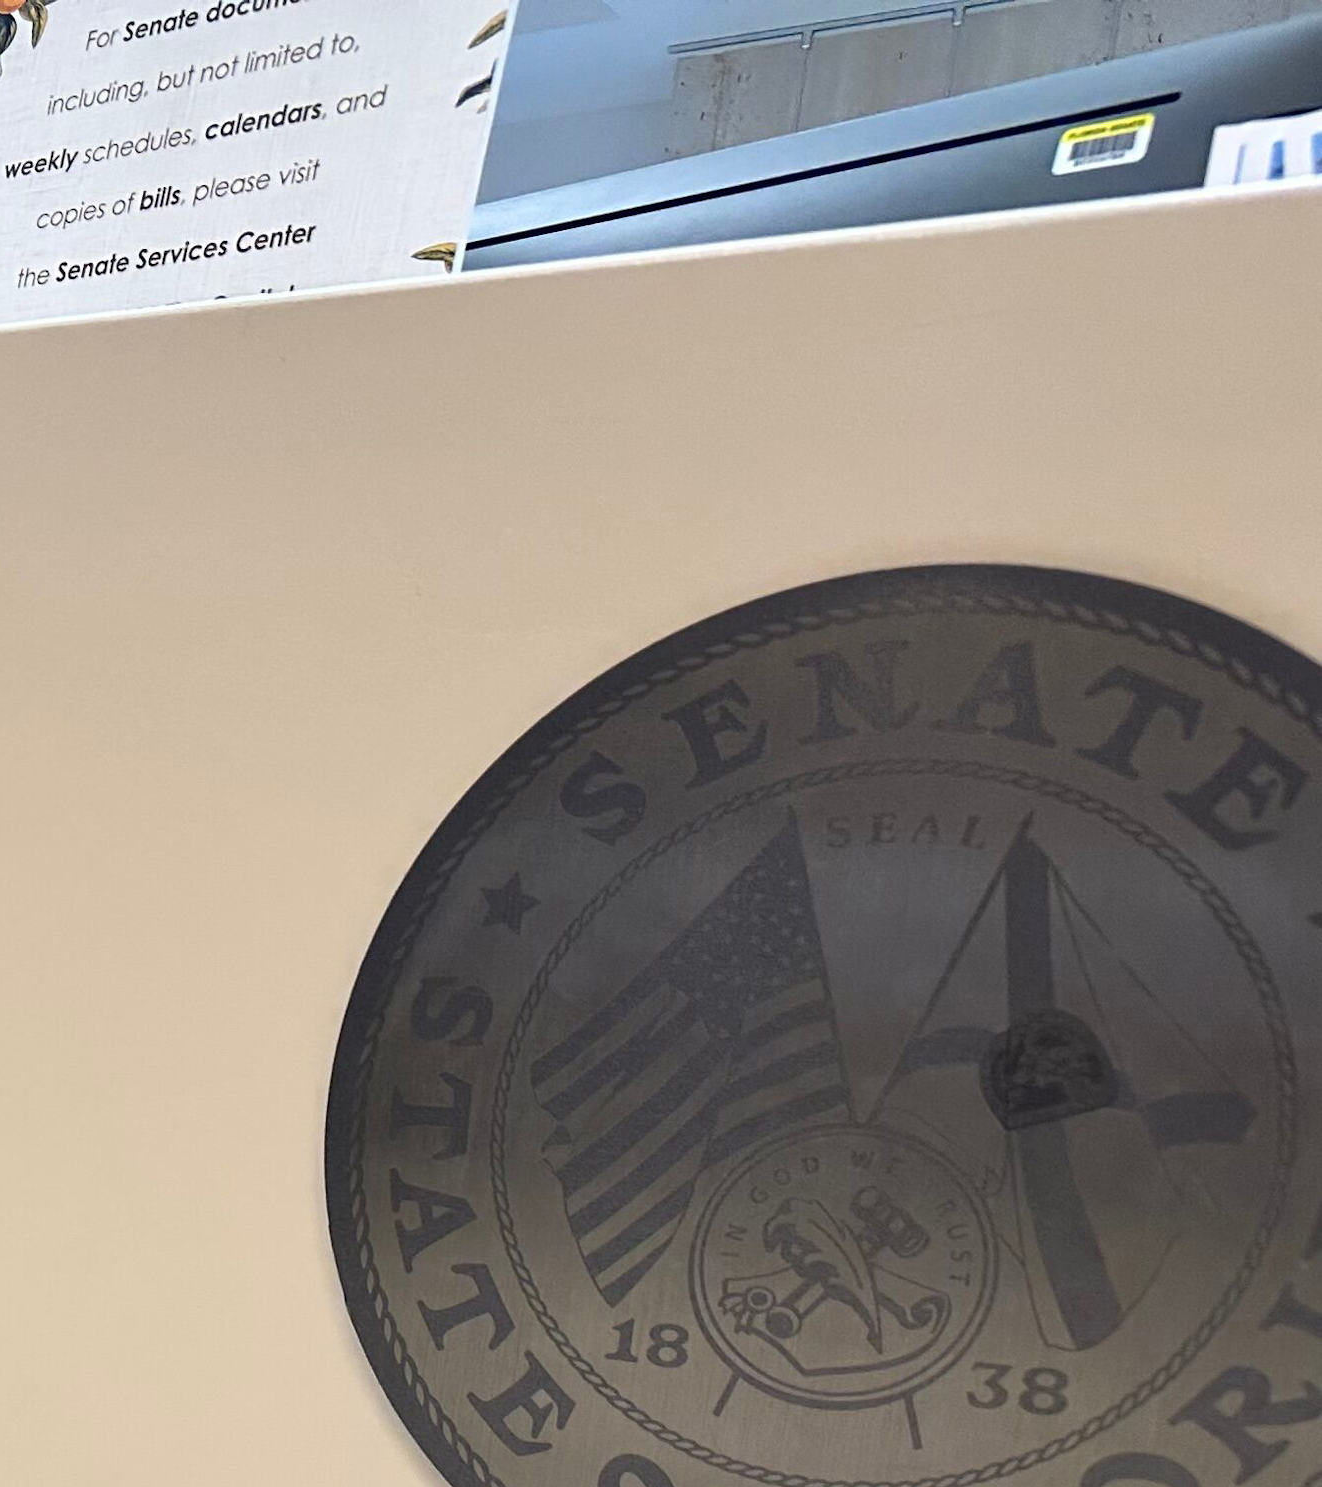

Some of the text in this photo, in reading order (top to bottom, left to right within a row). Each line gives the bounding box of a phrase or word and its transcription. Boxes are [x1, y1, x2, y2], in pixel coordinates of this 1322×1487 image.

[85, 28, 120, 51] For
[123, 8, 199, 42] Senate
[47, 32, 360, 116] including, but not limited to,
[4, 84, 388, 180] weekly schedules, calendars, and
[36, 159, 321, 230] copies of bills, please visit
[17, 223, 317, 289] the Senate Services Center
[559, 641, 1310, 852] SENATE
[824, 812, 985, 850] SEAL
[390, 975, 578, 1460] STATE
[720, 1223, 749, 1259] IN
[749, 1156, 821, 1205] GOD
[606, 1320, 690, 1370] 18
[966, 1361, 1070, 1417] 38
